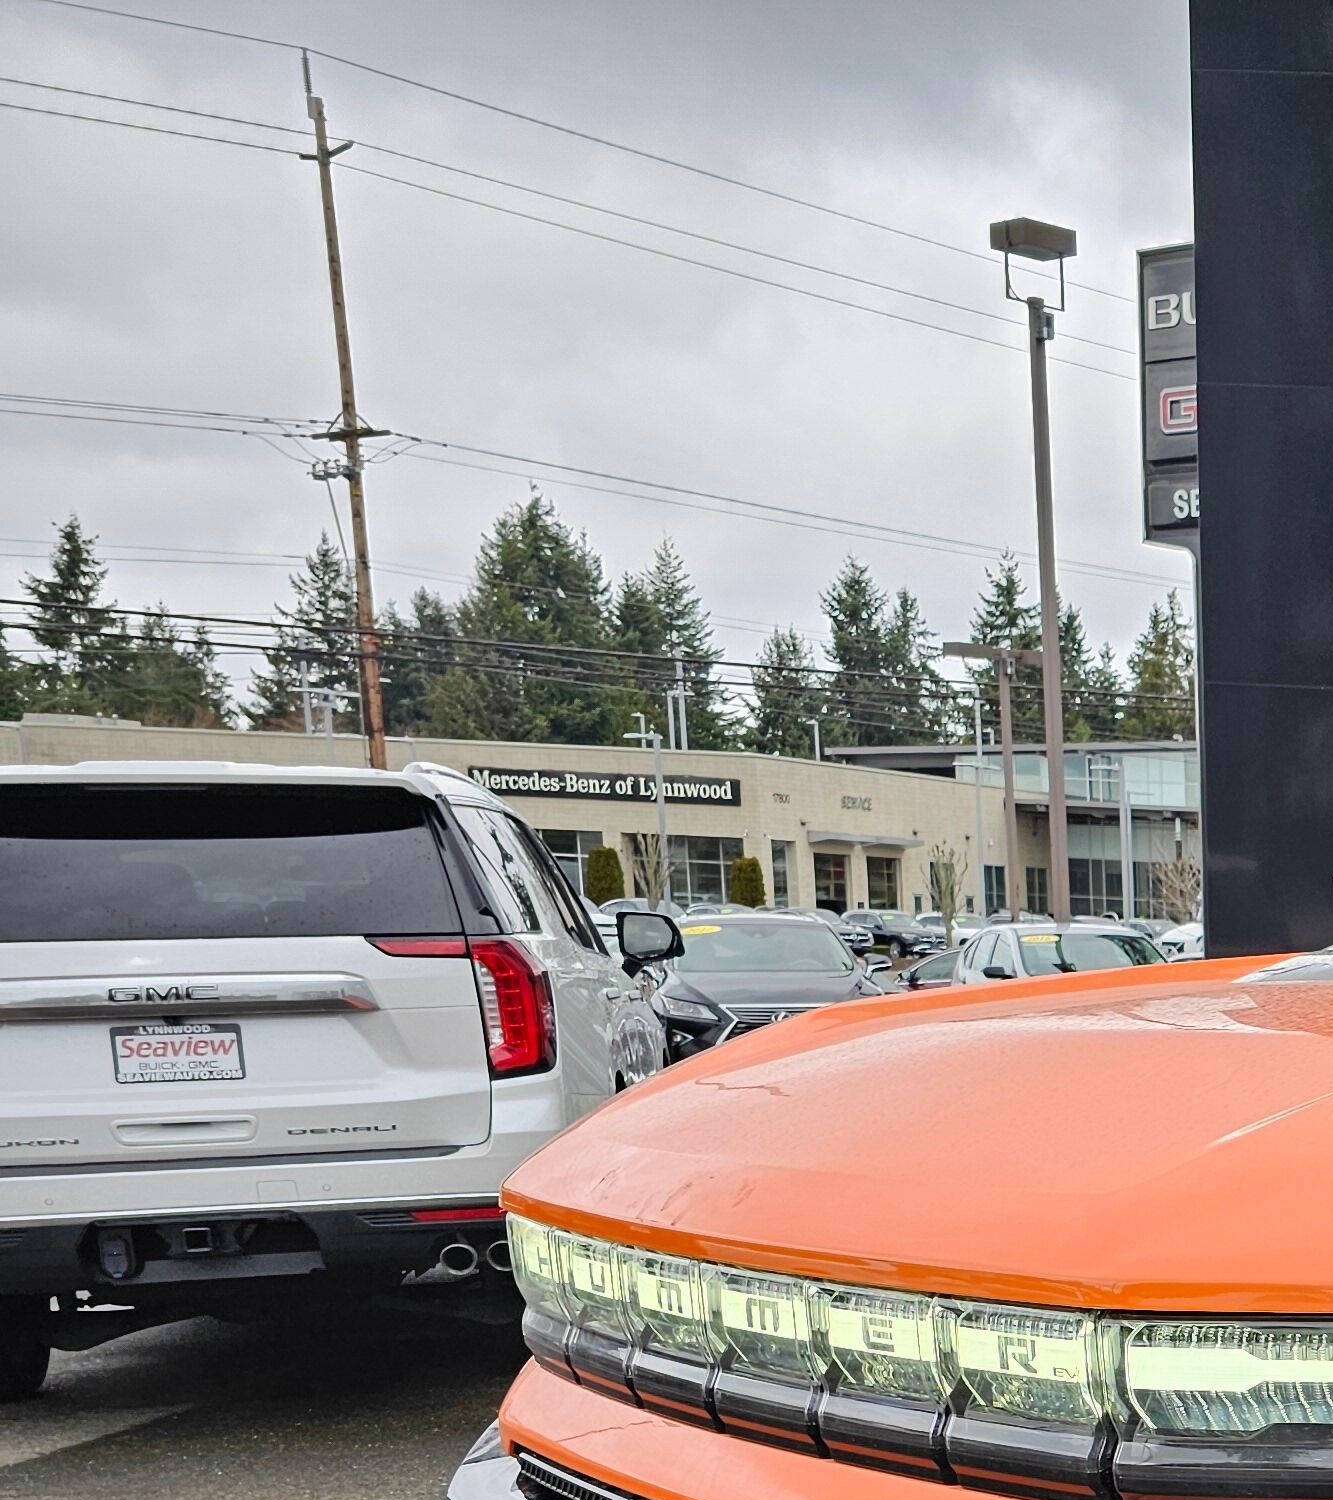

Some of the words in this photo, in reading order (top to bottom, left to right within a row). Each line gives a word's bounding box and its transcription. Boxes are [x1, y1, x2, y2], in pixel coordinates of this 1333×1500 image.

[472, 769, 611, 793] Mercedes-Benz
[615, 777, 635, 795] of
[639, 778, 733, 801] Lynnwood
[841, 795, 873, 811] SERVICE
[107, 985, 220, 1002] GMC
[138, 1025, 212, 1035] LYNNWOOD
[120, 1036, 237, 1058] Seaview
[139, 1061, 180, 1071] BUICK
[188, 1060, 219, 1069] GMC
[287, 1124, 397, 1136] DENALI
[0, 1138, 80, 1148] UKON
